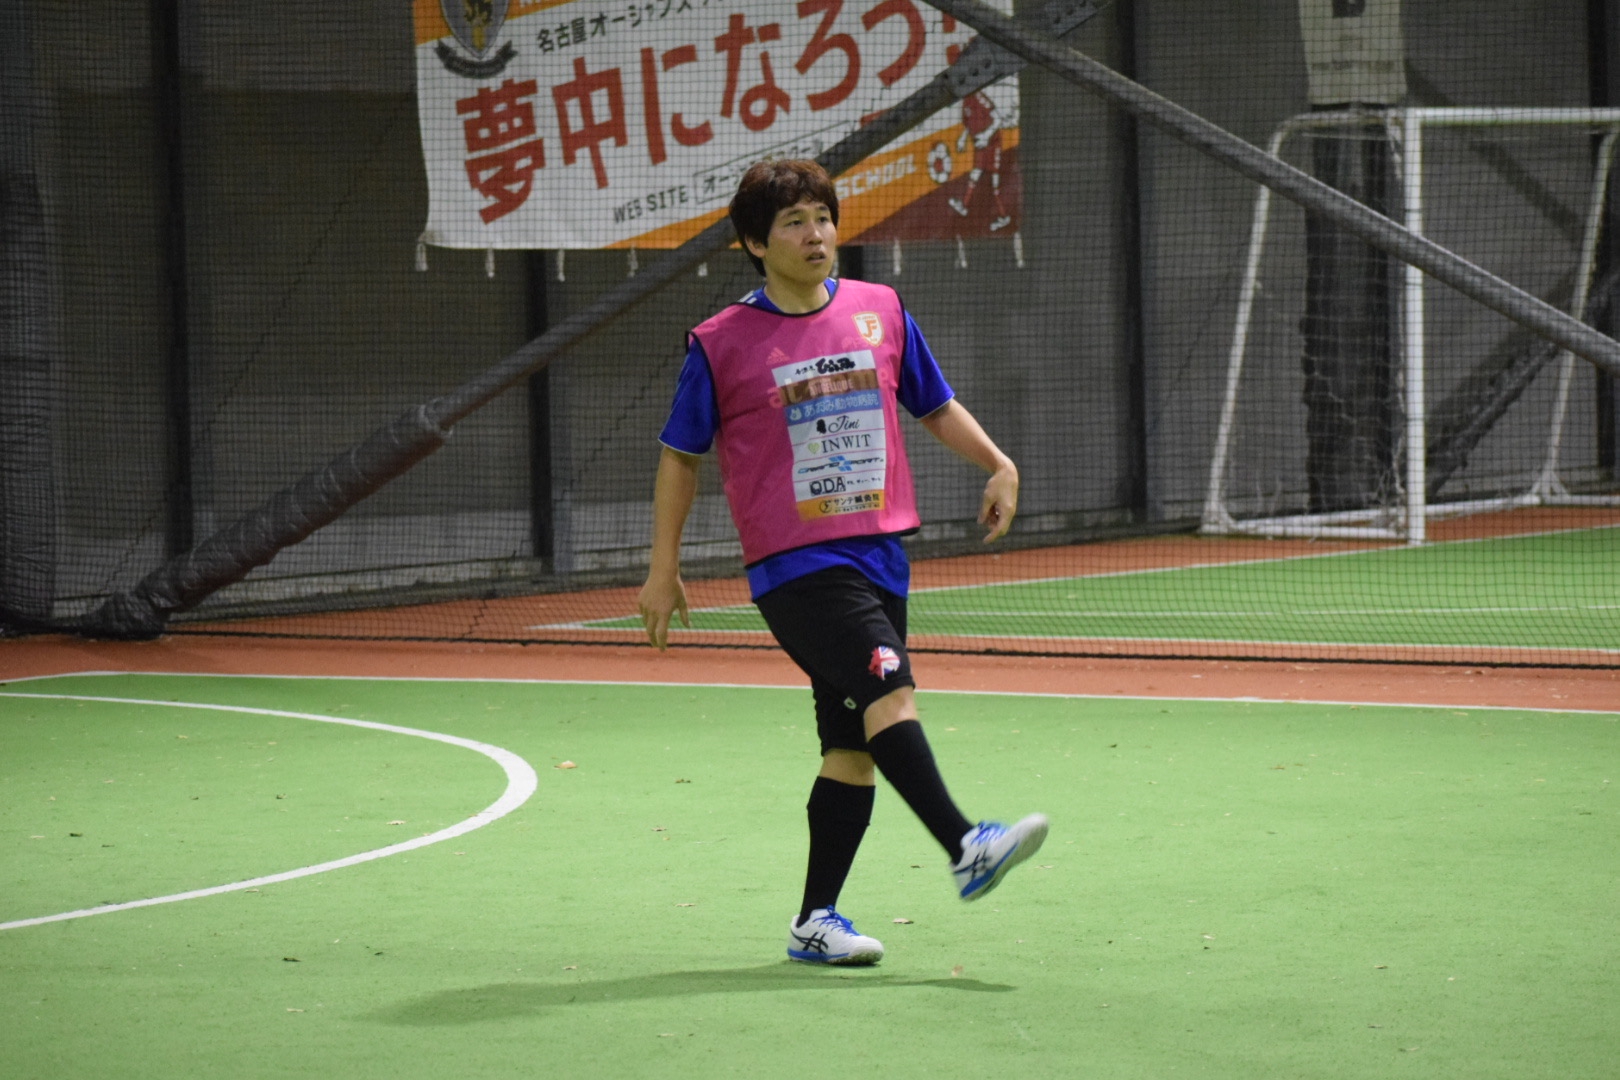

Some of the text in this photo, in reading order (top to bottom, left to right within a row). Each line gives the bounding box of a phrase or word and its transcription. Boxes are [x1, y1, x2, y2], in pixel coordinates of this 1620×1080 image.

[536, 0, 709, 53] 名古屋オーシャン
[834, 153, 917, 201] SCHOOL
[646, 185, 689, 212] SITE
[821, 434, 871, 453] INWIT
